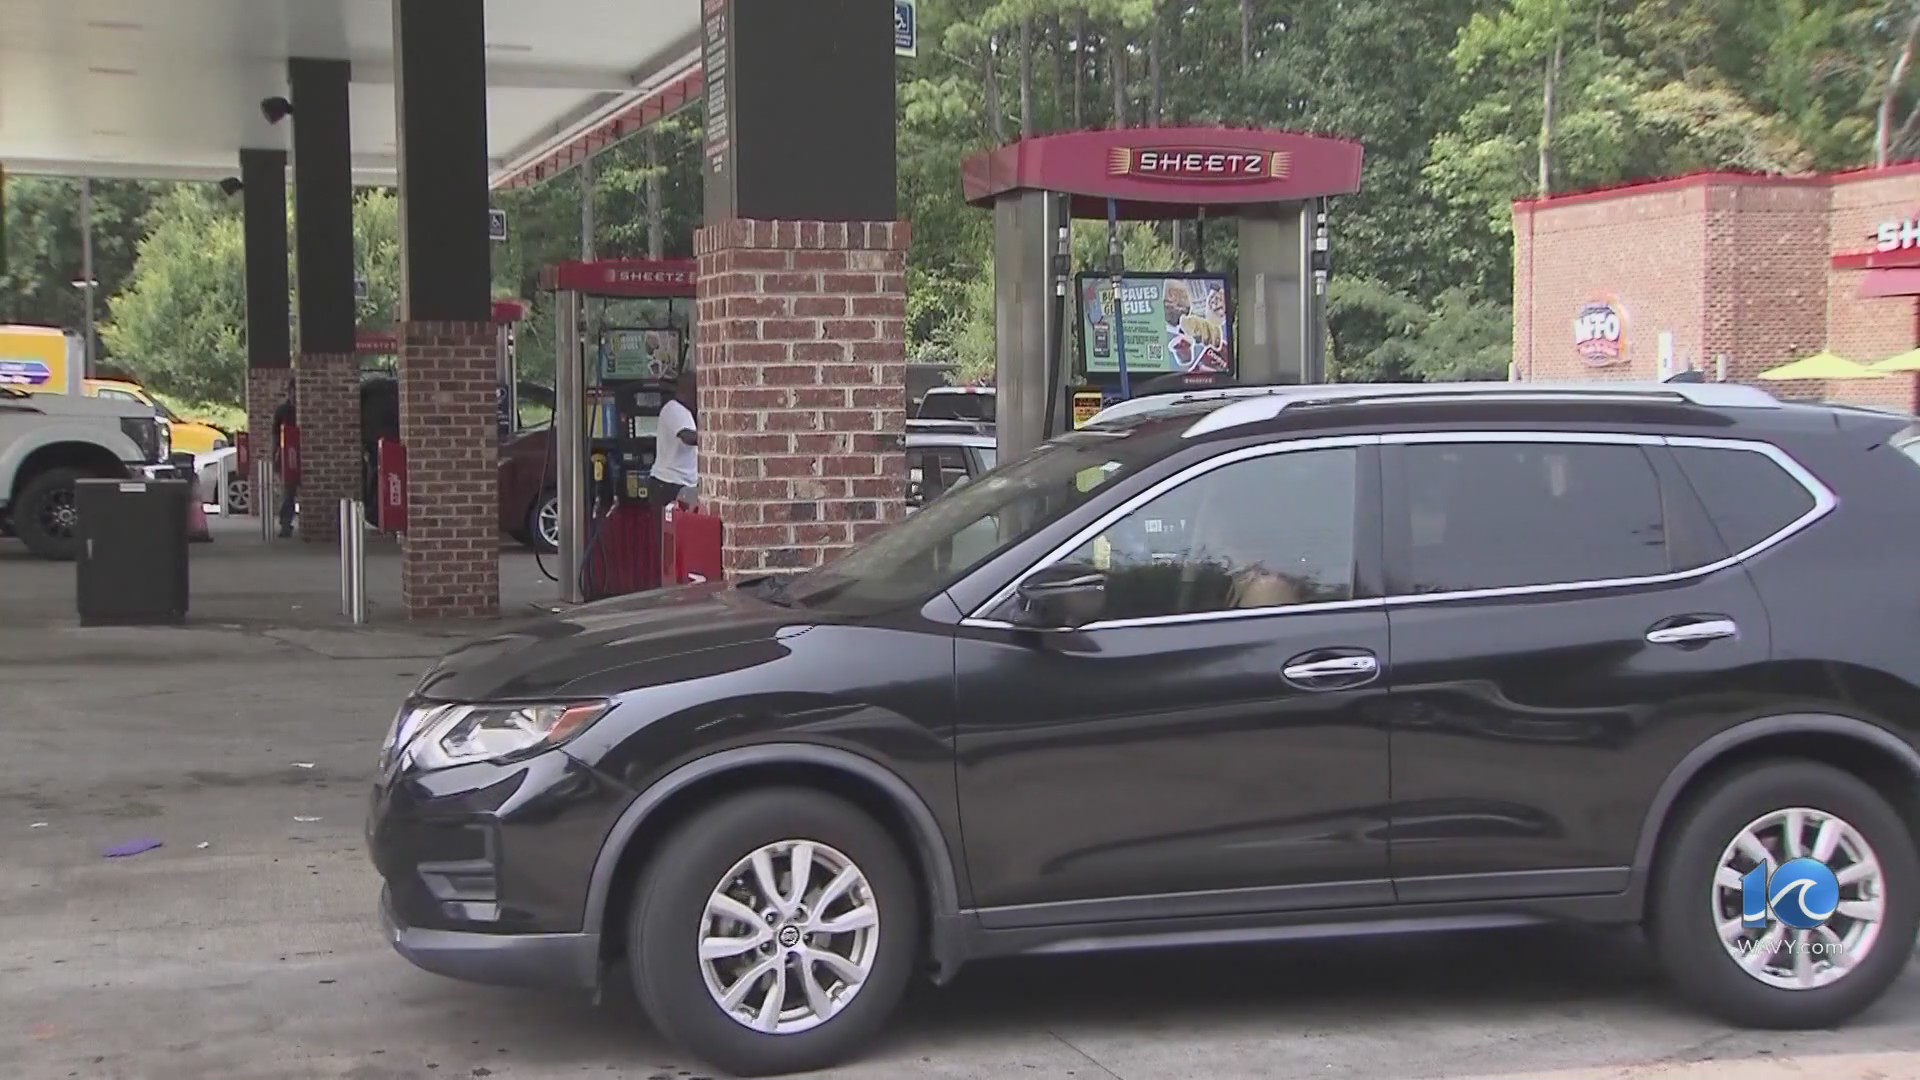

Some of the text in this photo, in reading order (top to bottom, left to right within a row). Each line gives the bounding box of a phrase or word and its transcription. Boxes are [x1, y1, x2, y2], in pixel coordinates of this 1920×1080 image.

[1140, 152, 1262, 173] SHEETZ
[620, 271, 685, 282] SHEETZ
[1121, 286, 1158, 301] FAVES
[1123, 300, 1152, 315] FUEL
